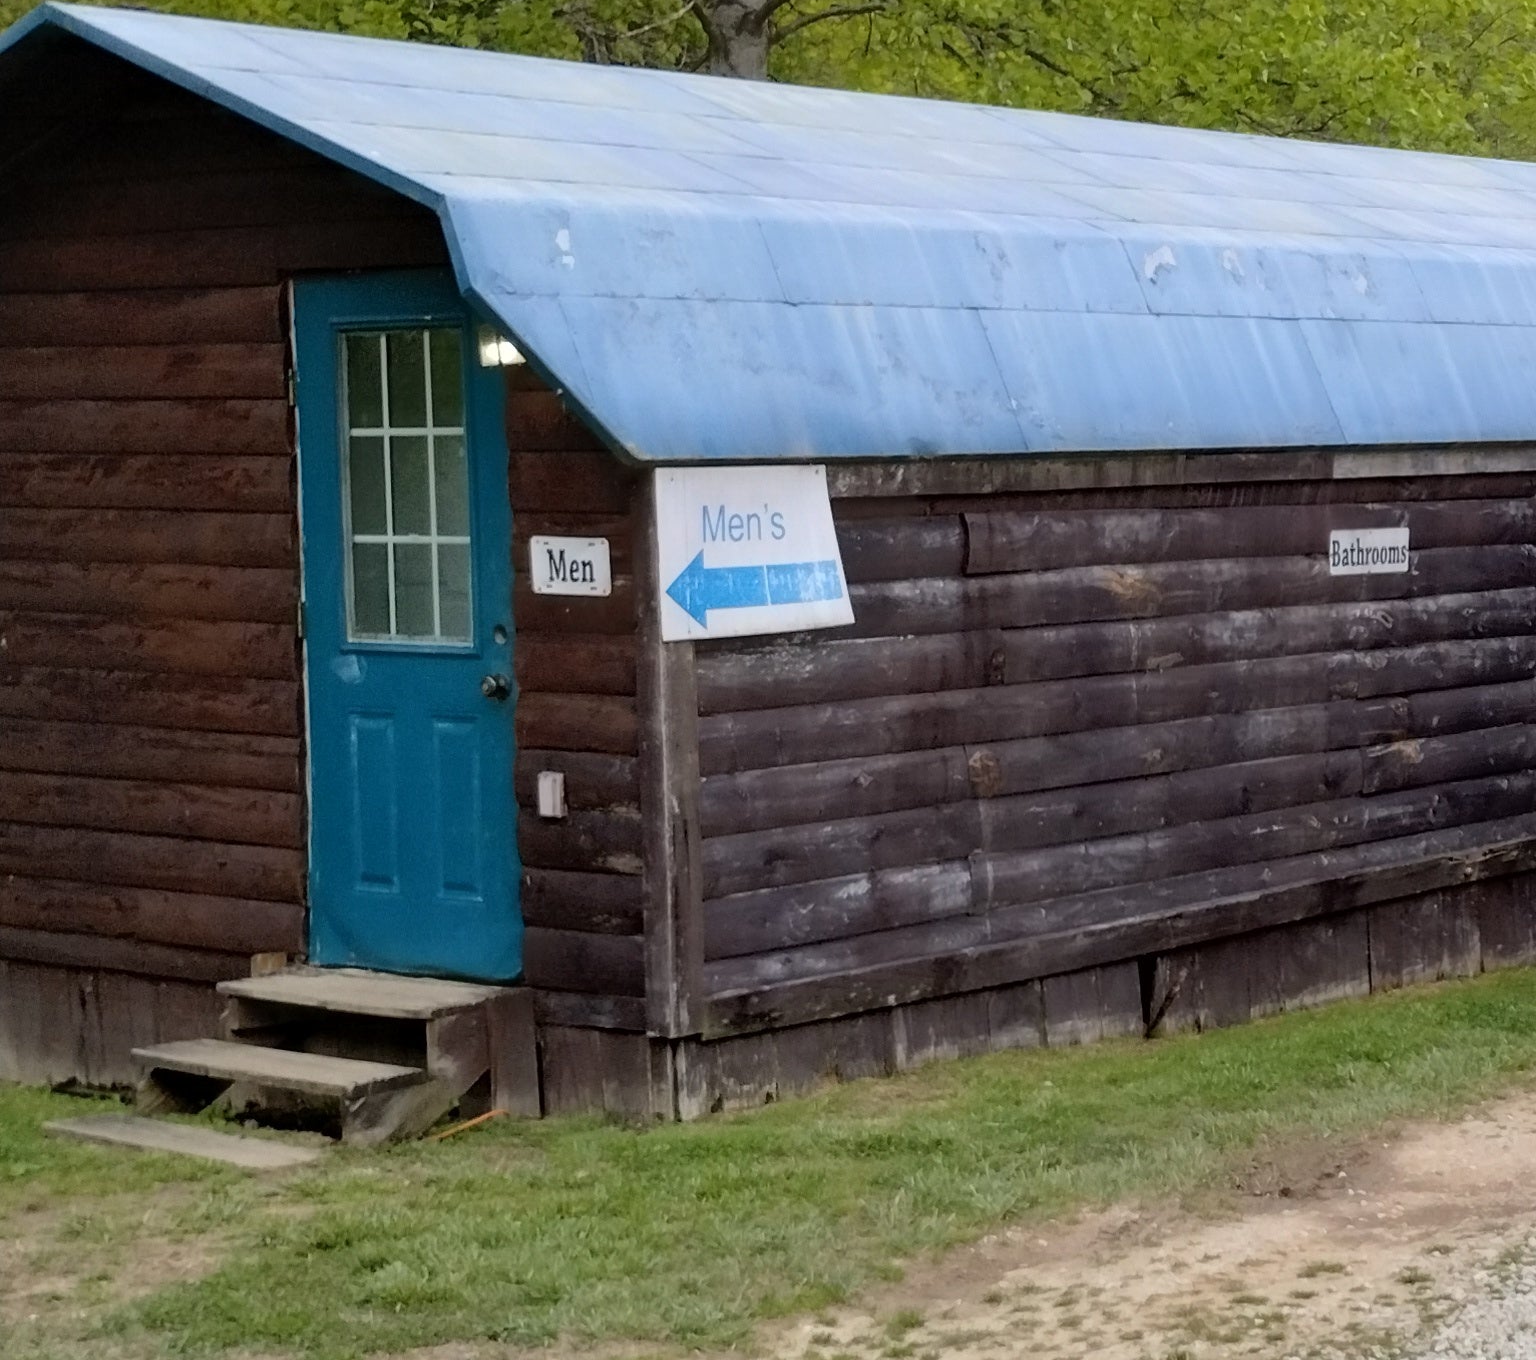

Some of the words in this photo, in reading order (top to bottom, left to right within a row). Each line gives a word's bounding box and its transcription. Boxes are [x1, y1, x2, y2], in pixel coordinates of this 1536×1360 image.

[702, 503, 786, 543] Men's
[546, 548, 596, 583] Men
[1332, 538, 1408, 567] Bathrooms
